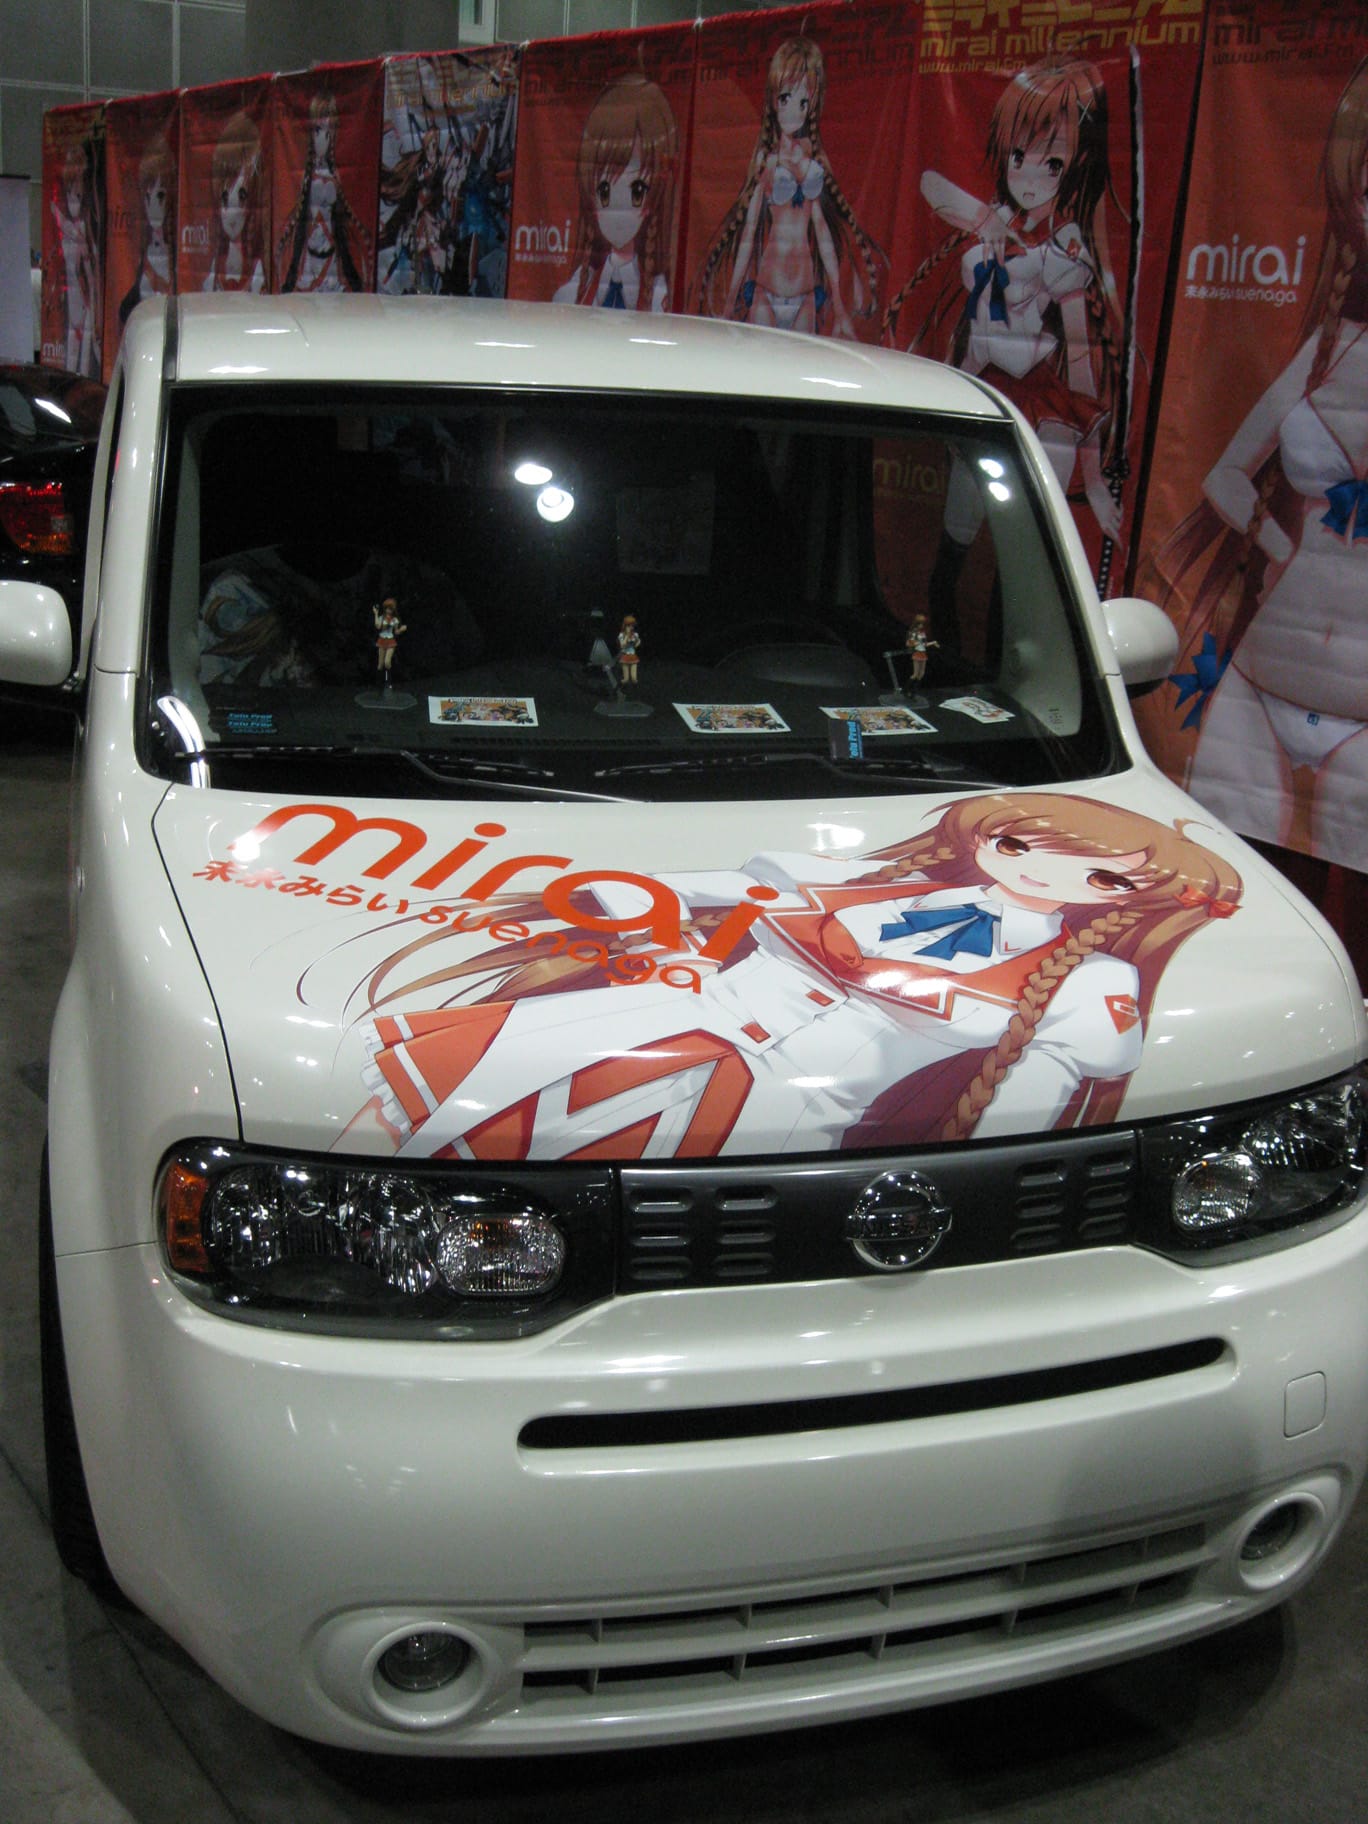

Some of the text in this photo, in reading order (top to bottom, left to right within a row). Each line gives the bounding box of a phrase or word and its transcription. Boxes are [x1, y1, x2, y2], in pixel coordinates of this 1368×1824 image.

[919, 30, 998, 57] mirai
[1004, 20, 1201, 54] millennium
[1186, 233, 1306, 286] mirai
[227, 804, 779, 961] mirai
[419, 905, 701, 995] suenaga
